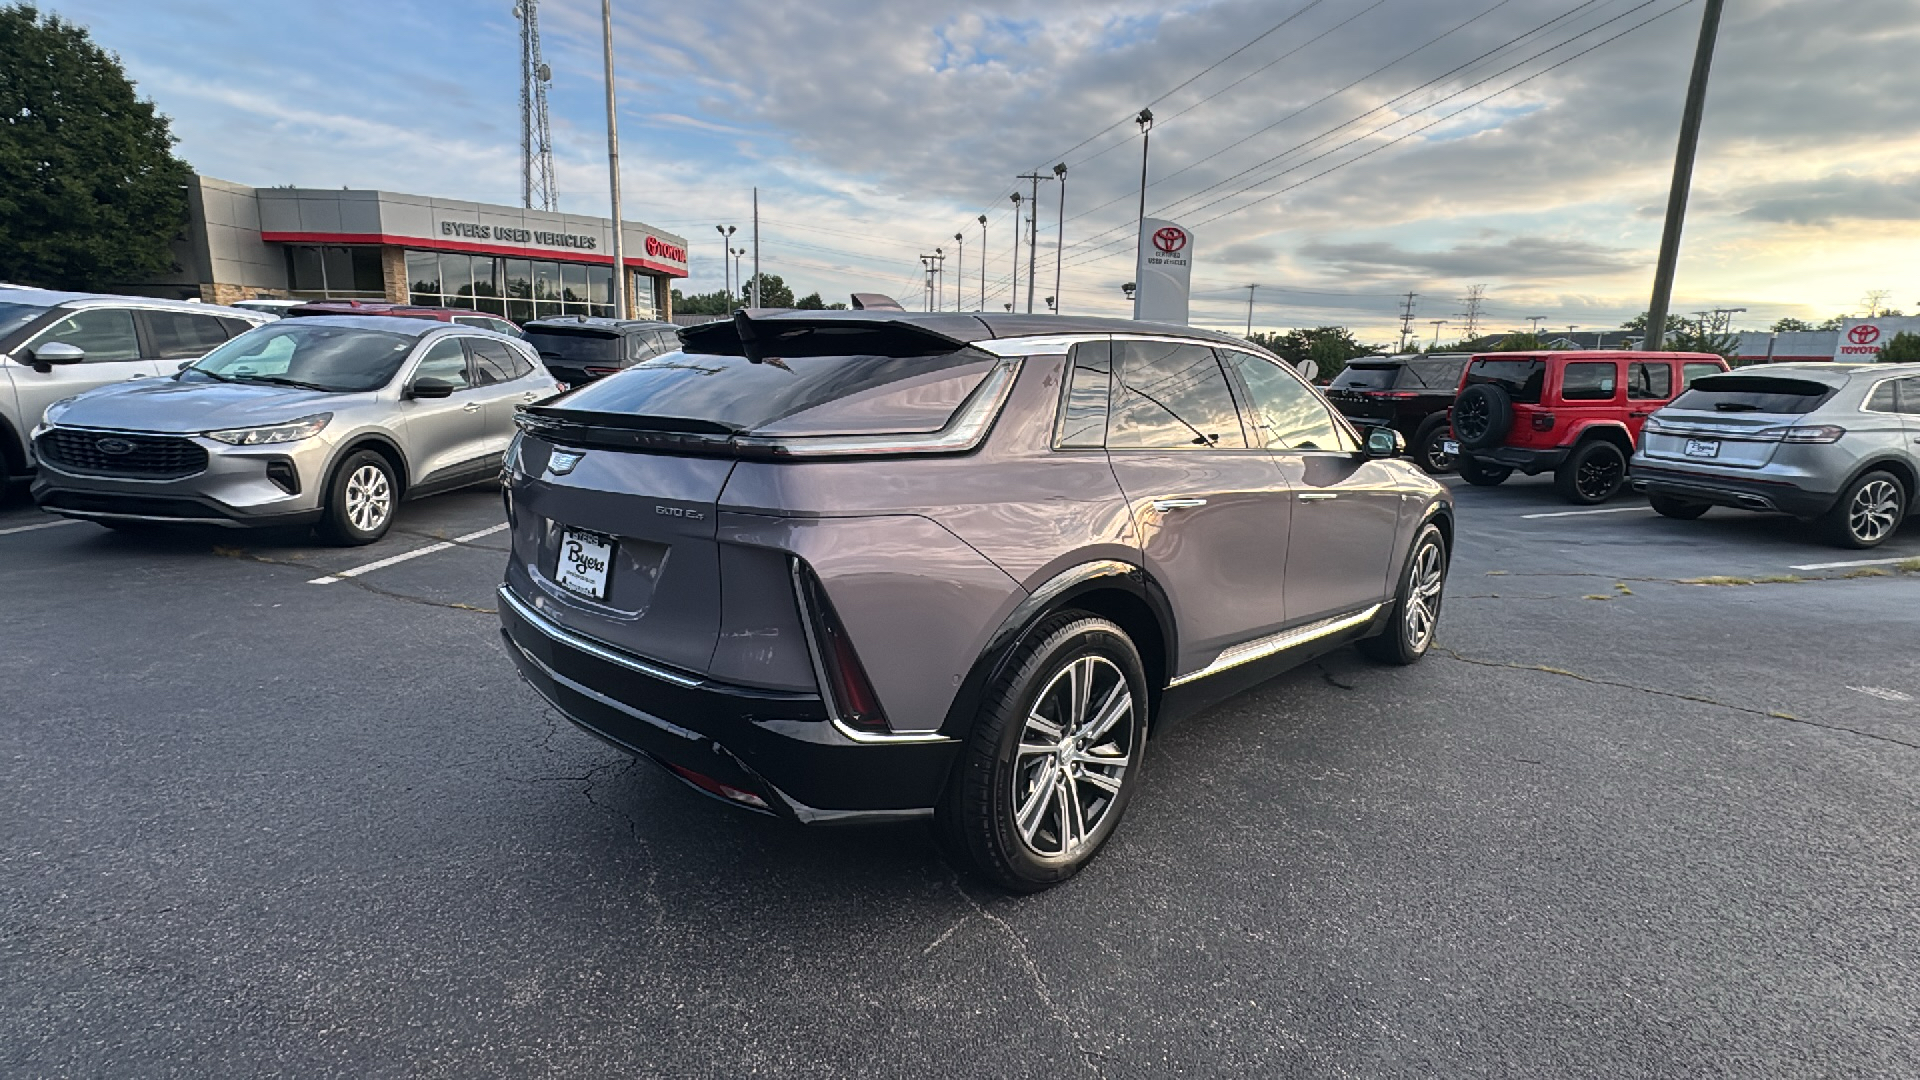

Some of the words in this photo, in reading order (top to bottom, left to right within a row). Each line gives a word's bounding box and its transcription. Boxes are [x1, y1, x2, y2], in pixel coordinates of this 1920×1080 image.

[441, 221, 490, 238] BYERS
[494, 226, 531, 243] USED
[534, 230, 597, 250] VEHICLES
[657, 241, 687, 264] TOYOTA
[1163, 258, 1186, 266] VEHICLES
[1840, 346, 1881, 354] TOYOTA
[566, 540, 605, 574] Byers
